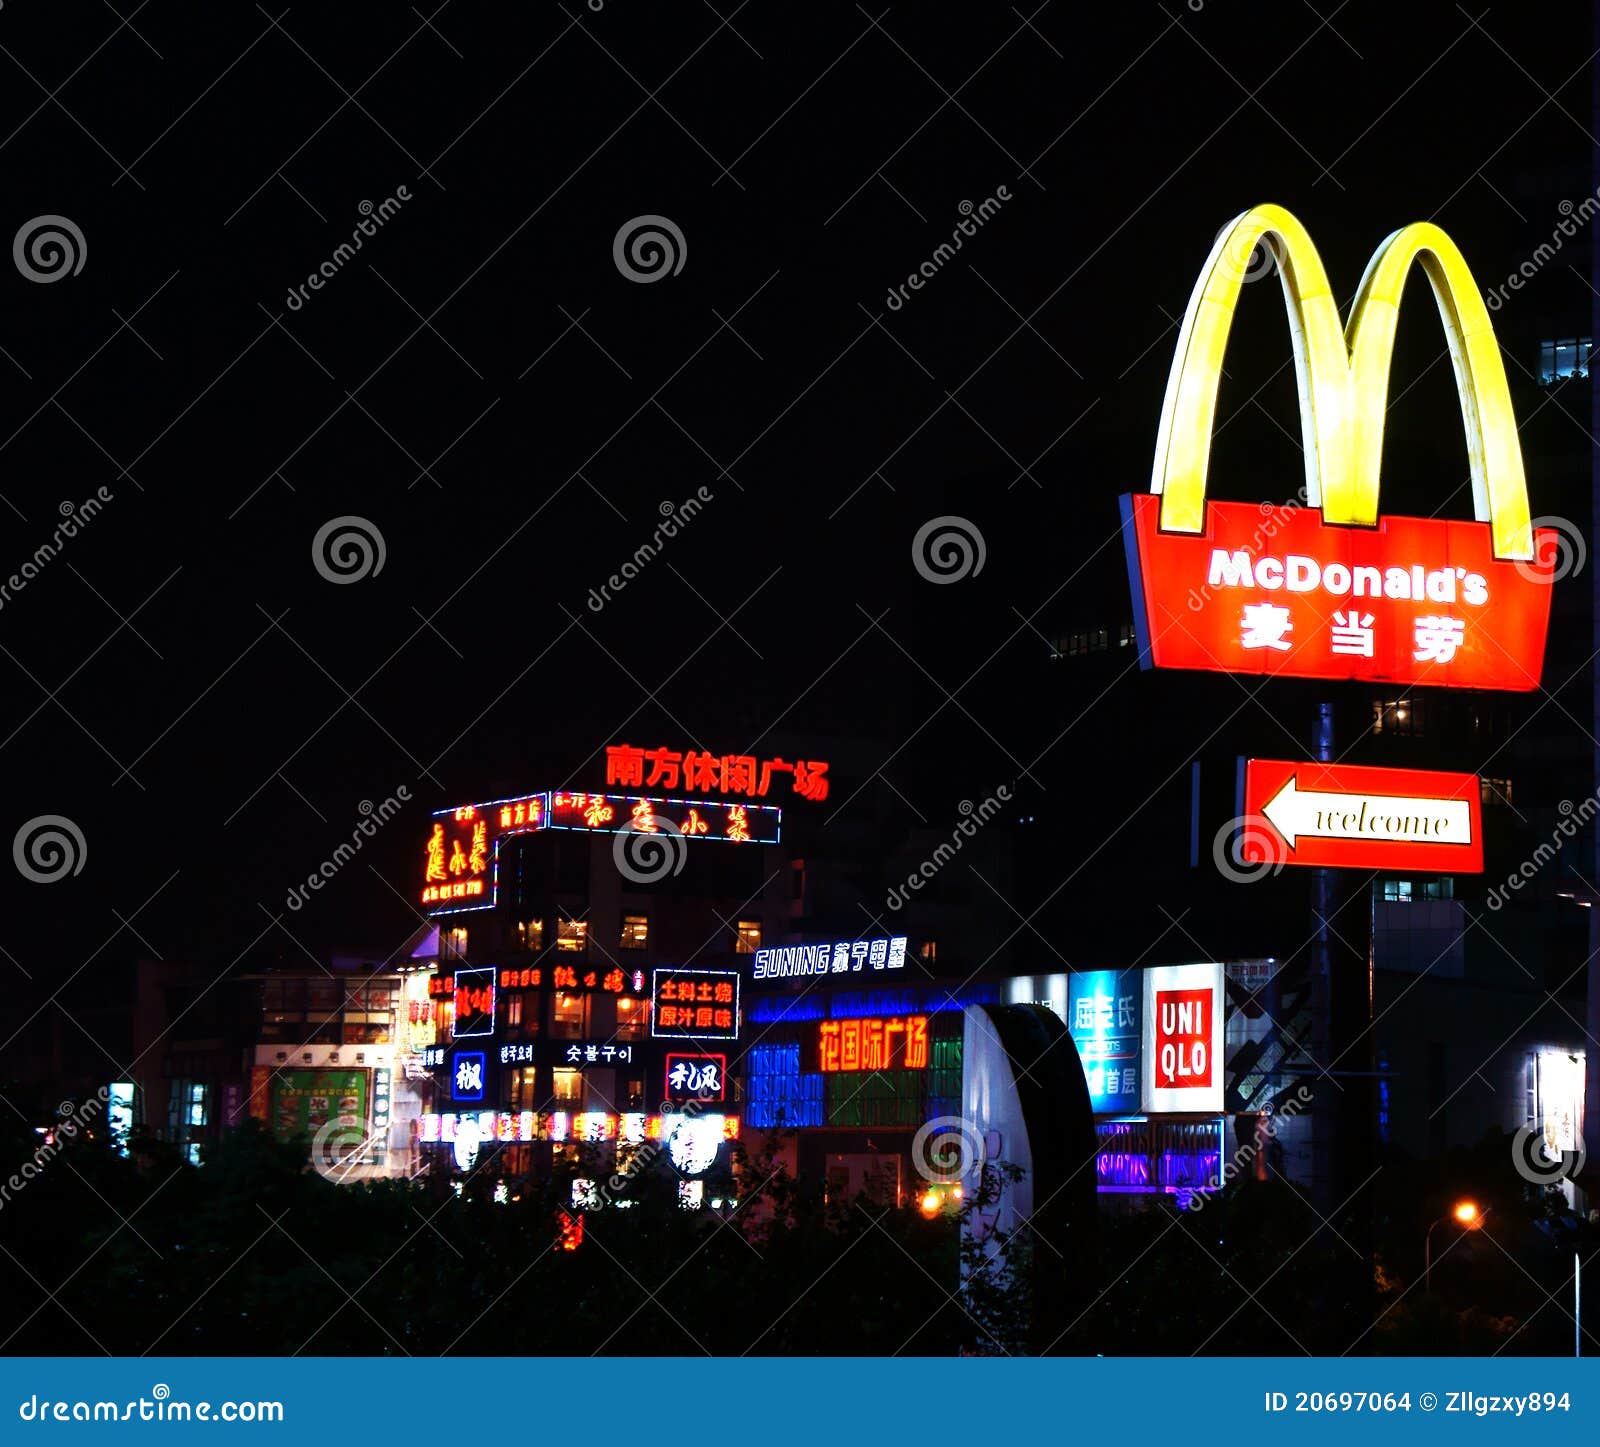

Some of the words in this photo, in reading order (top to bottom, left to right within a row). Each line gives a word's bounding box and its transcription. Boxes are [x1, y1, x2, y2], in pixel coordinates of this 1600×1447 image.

[1207, 549, 1489, 607] McDonald's
[1240, 602, 1465, 664] 麦当劳
[605, 744, 830, 801] 南方休闲广场
[554, 795, 587, 809] 6-7F
[1316, 801, 1450, 836] welcome
[753, 943, 831, 979] SUNING
[831, 936, 908, 974] 苏宁电器
[659, 980, 733, 1004] 土料土烧
[658, 1005, 733, 1029] 原汁原味
[1161, 1000, 1203, 1036] UNI
[818, 1014, 929, 1073] 花国际广场
[1160, 1041, 1208, 1083] QLO
